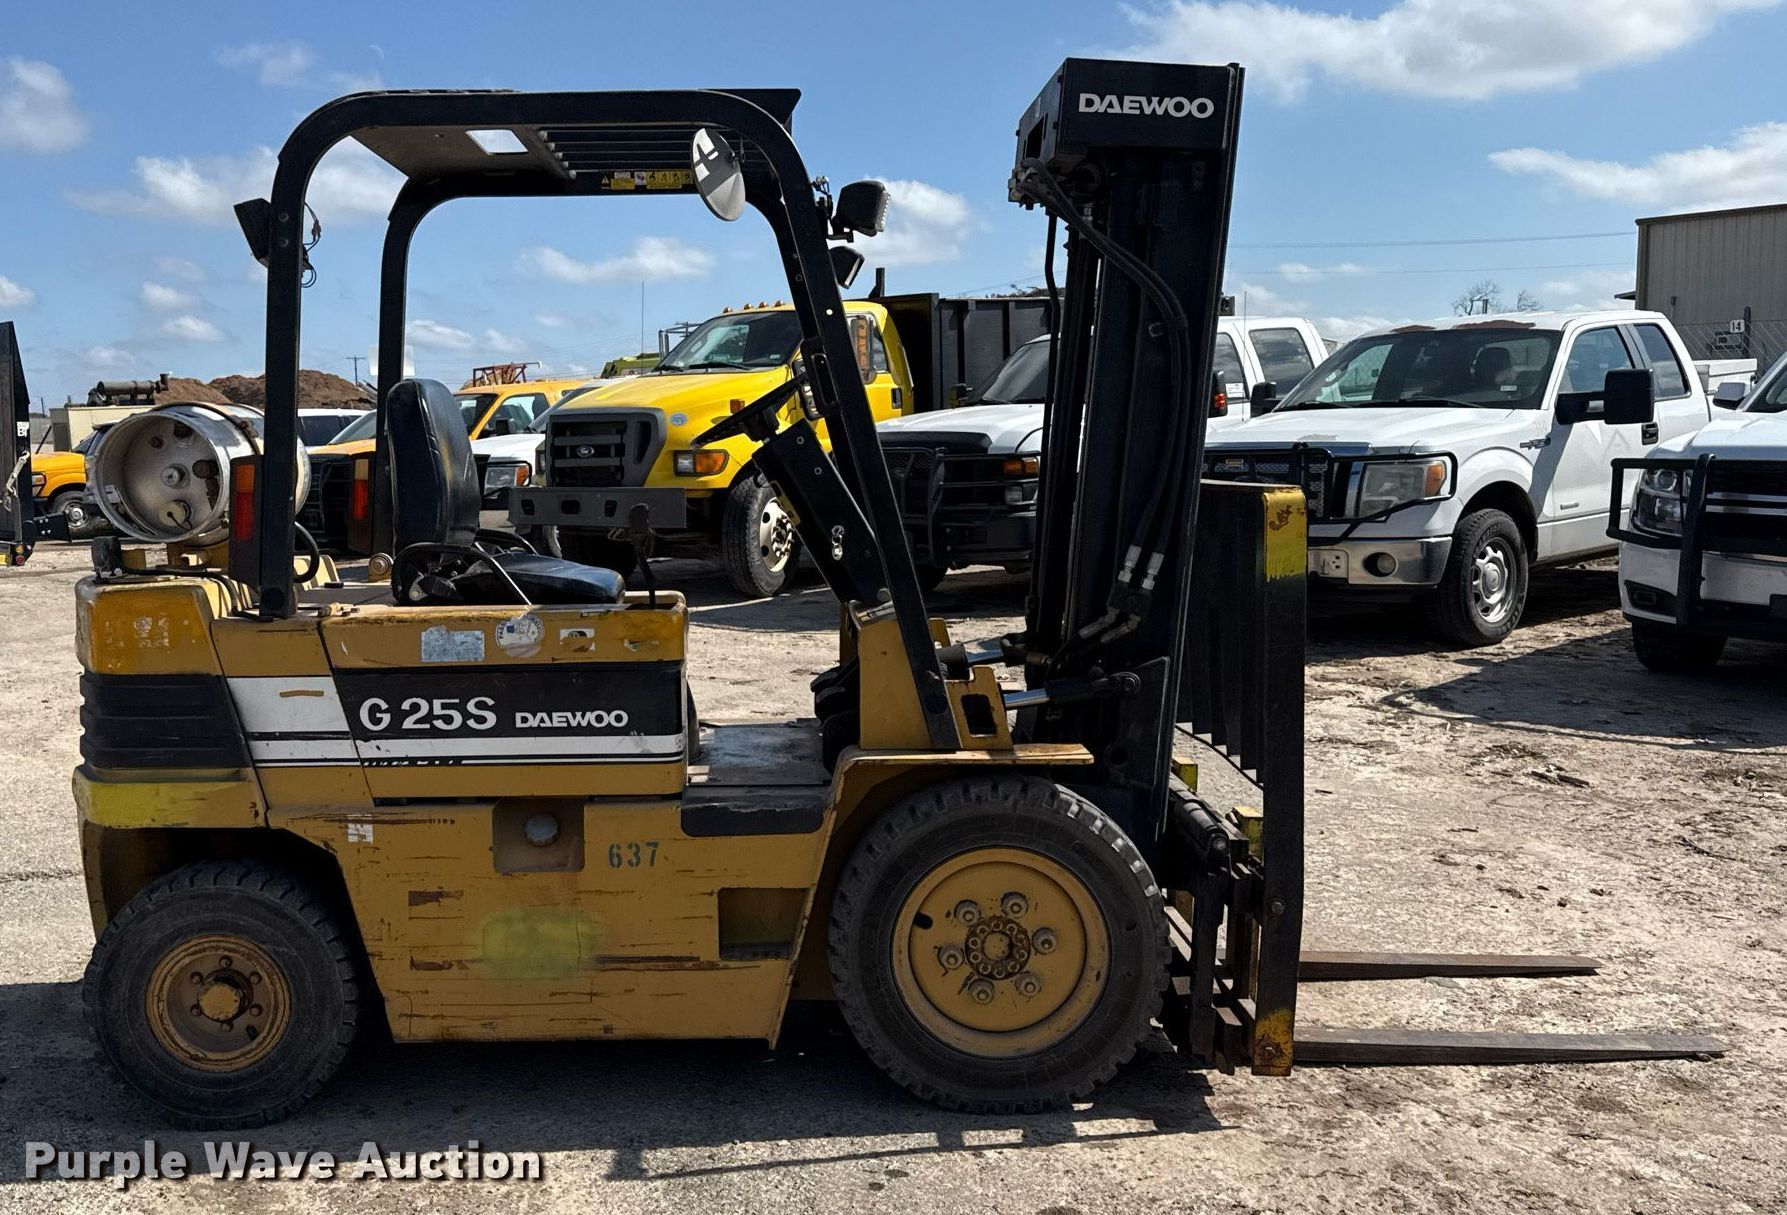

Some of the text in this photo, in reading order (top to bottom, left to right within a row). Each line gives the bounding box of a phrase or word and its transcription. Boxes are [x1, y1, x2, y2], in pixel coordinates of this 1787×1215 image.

[1078, 92, 1215, 119] DAEWOO
[1731, 321, 1742, 332] 14
[359, 696, 498, 731] G 25S
[515, 709, 629, 728] DAEWOO
[608, 841, 660, 868] 637
